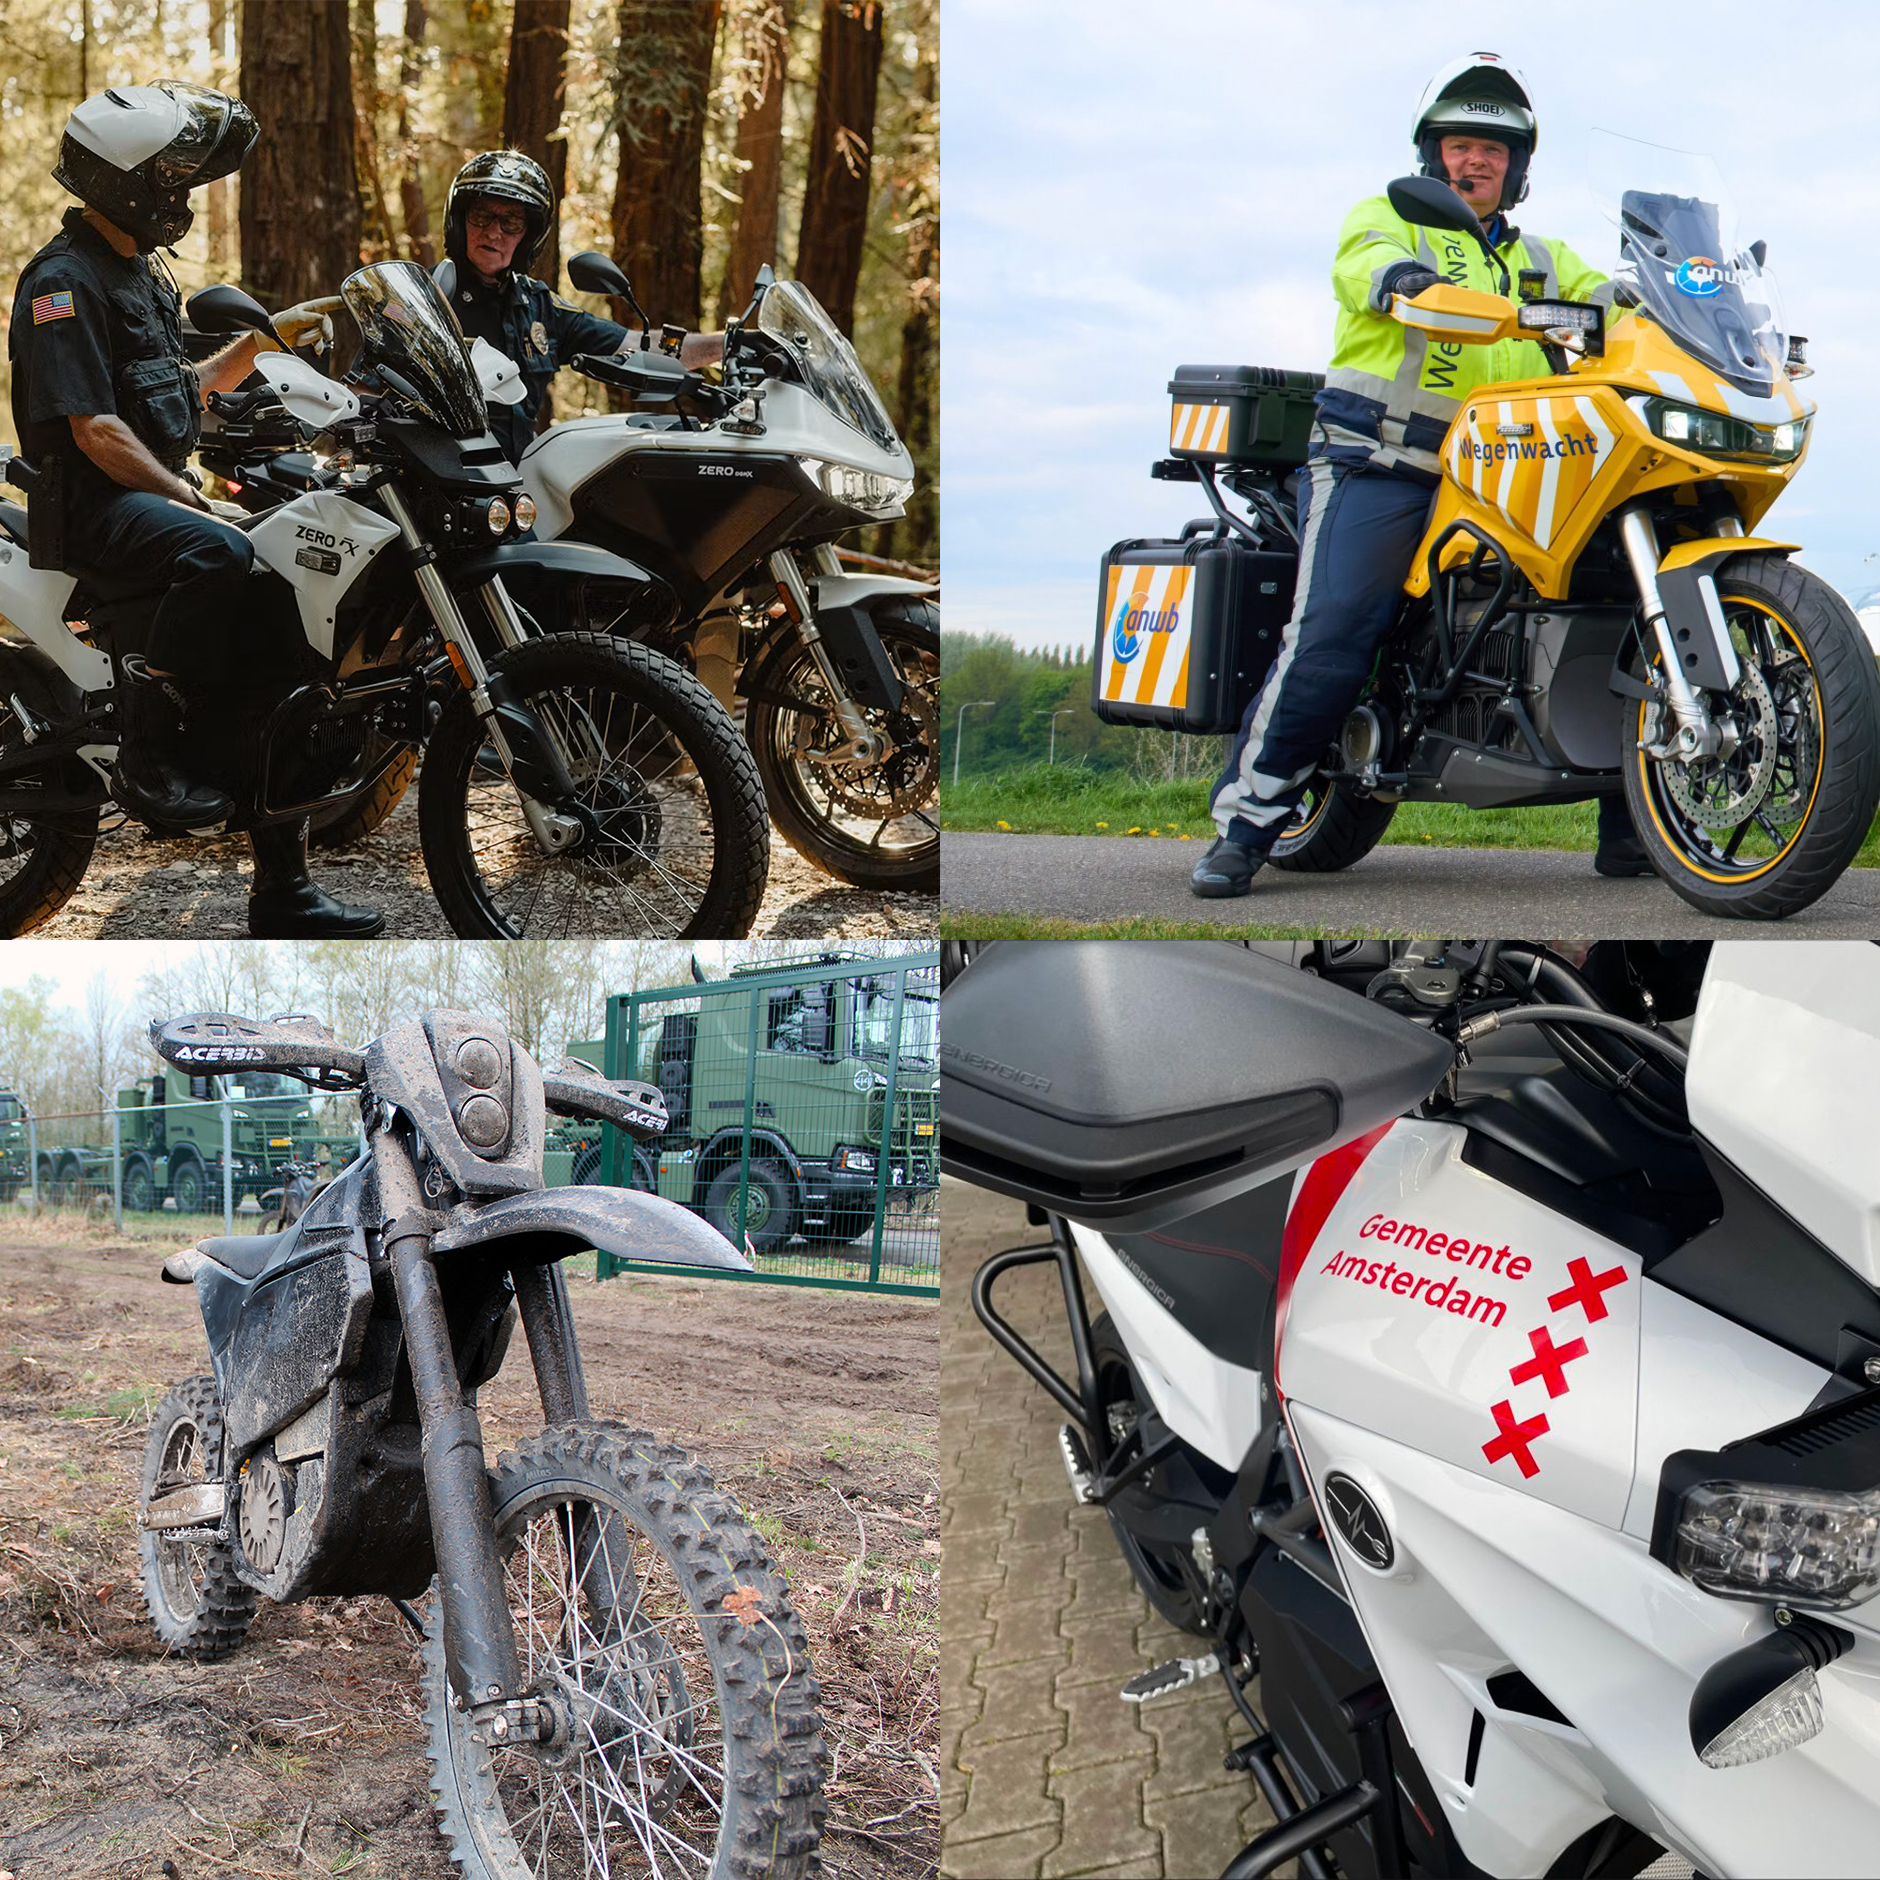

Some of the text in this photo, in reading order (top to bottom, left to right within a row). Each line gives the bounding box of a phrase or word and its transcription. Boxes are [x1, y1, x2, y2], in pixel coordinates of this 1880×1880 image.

[1467, 102, 1500, 115] SHOEI
[1460, 433, 1599, 468] Wegenwacht
[698, 465, 734, 476] ZERO
[295, 524, 336, 548] ZERO
[1126, 601, 1179, 633] anwb
[1359, 1213, 1533, 1281] Gemeente
[1320, 1250, 1507, 1328] Amsterdam
